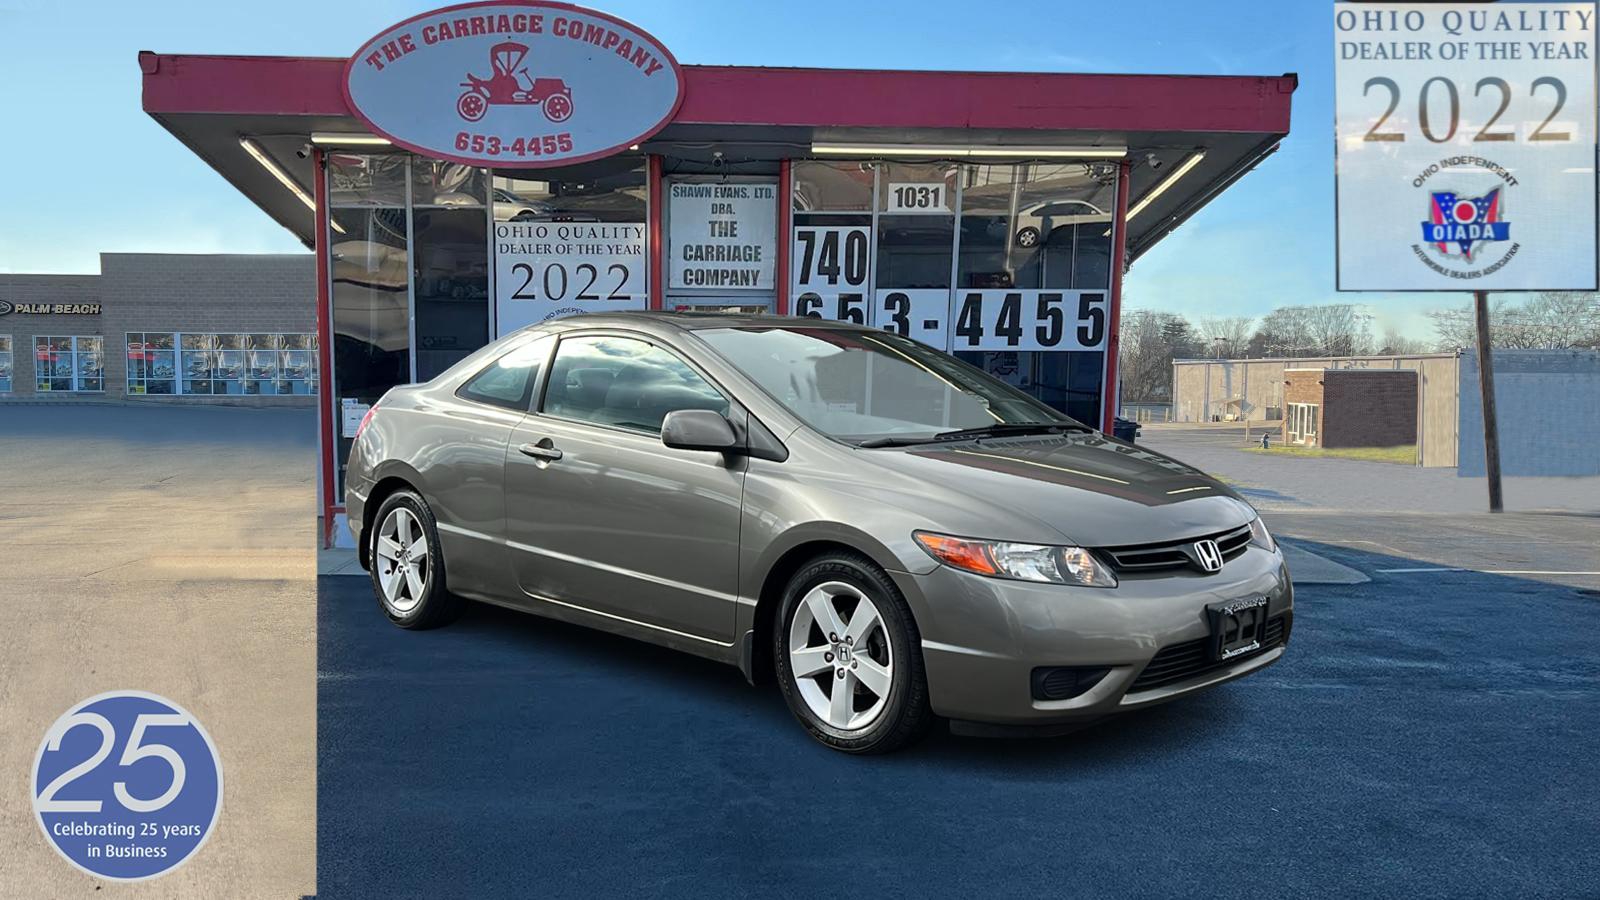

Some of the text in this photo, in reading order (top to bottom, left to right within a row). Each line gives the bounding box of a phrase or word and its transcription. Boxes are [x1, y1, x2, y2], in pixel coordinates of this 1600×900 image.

[1336, 10, 1593, 36] OHIO QUALITY
[365, 14, 664, 78] THE CARRIAGE COMPANY
[1340, 42, 1590, 60] DEALER OF THE YEAR
[1363, 76, 1571, 143] 2022
[455, 132, 573, 157] 653-4455
[1413, 155, 1519, 188] OHIO INDEPENDENT
[672, 186, 712, 198] SHAWN
[754, 187, 775, 199] LTD.
[894, 186, 941, 208] 1031
[711, 203, 736, 215] DBA.
[497, 226, 644, 241] OHIO QUALITY
[708, 220, 738, 238] THE
[1432, 224, 1496, 241] OIADA
[499, 243, 642, 255] DEALER OF THE YEAR
[683, 244, 762, 262] CARRIAGE
[797, 229, 867, 286] 740
[1411, 242, 1521, 280] AUTOMOBILE DEALERS ASSOCIATION
[511, 262, 631, 301] 2022
[683, 268, 761, 286] COMPANY
[15, 304, 100, 314] PALM BEACH
